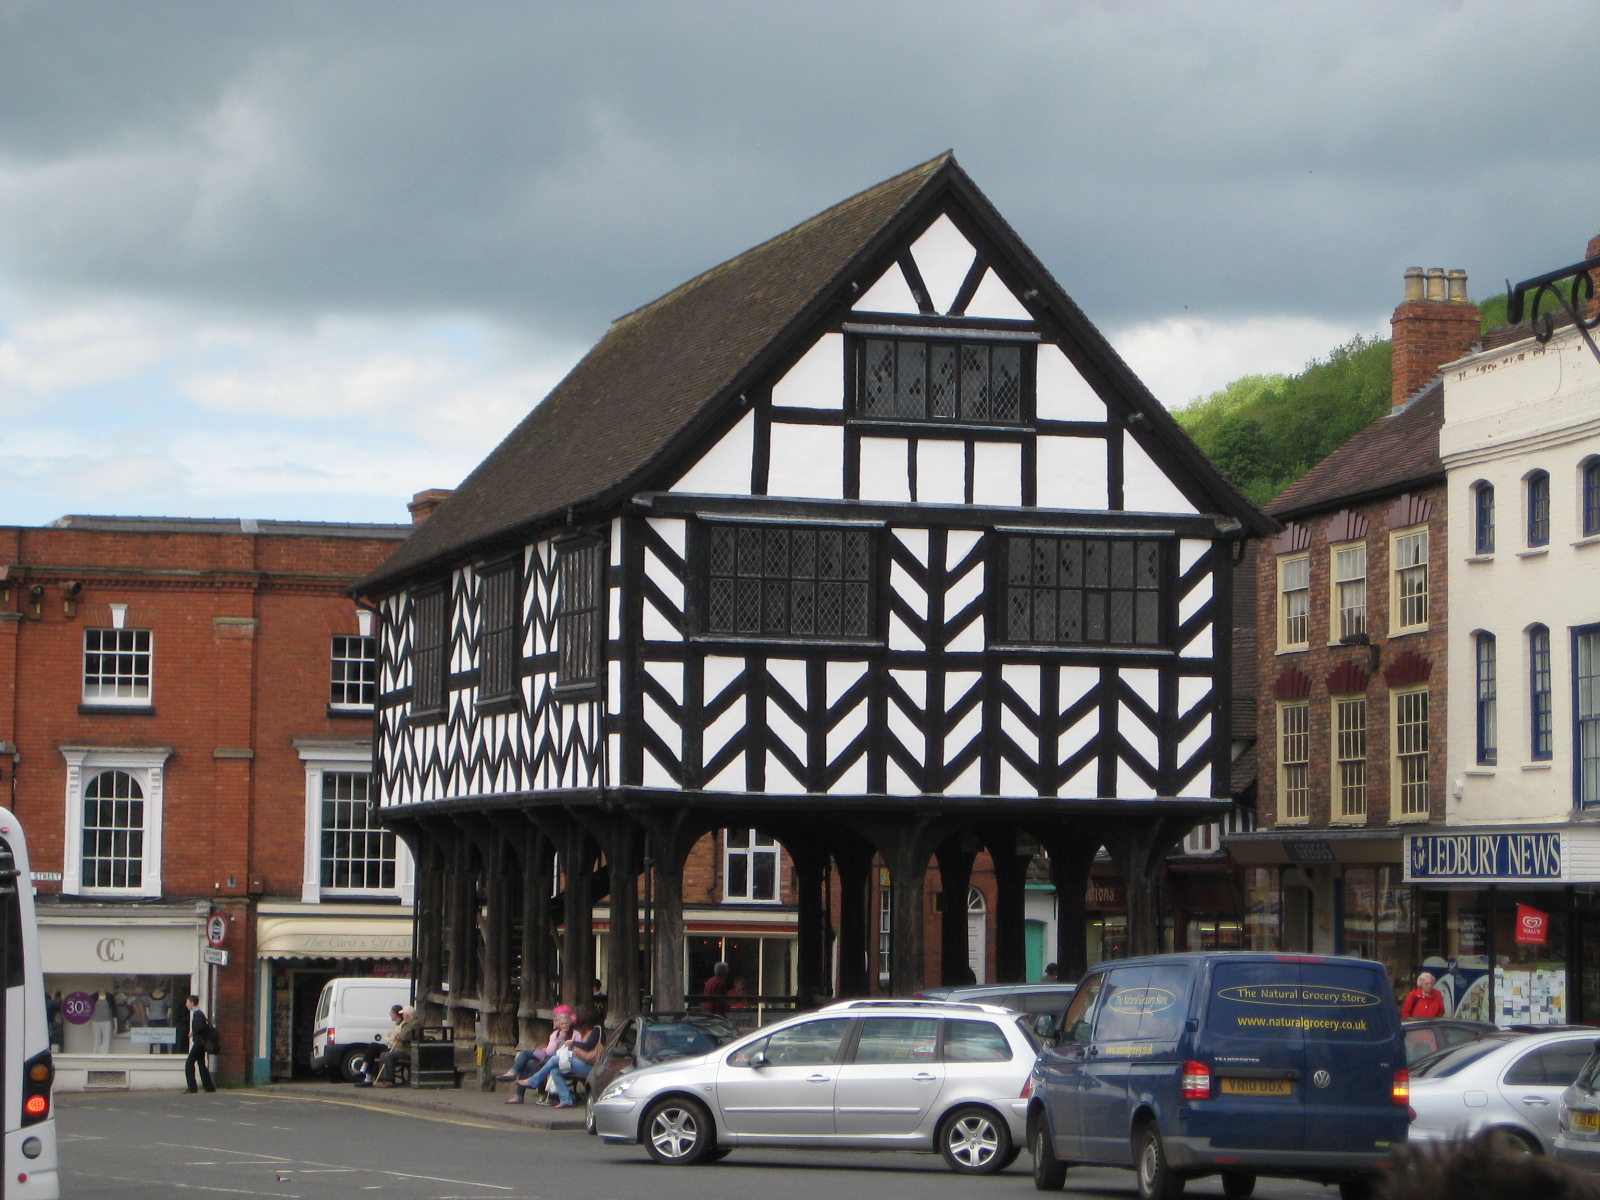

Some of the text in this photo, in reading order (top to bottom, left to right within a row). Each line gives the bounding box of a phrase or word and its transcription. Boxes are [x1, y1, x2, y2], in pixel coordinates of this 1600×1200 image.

[1294, 842, 1332, 860] GREGGS
[1428, 835, 1560, 875] LEDBURY NEWS
[33, 872, 60, 880] STREET
[302, 936, 323, 947] The
[329, 936, 357, 947] Card
[371, 936, 393, 950] Gift
[1125, 995, 1139, 1005] Natural
[1155, 994, 1168, 1005] Store
[1237, 988, 1366, 1003] The Natural Grocery Store
[1237, 1016, 1367, 1031] www.naturalgrocery.co.uk
